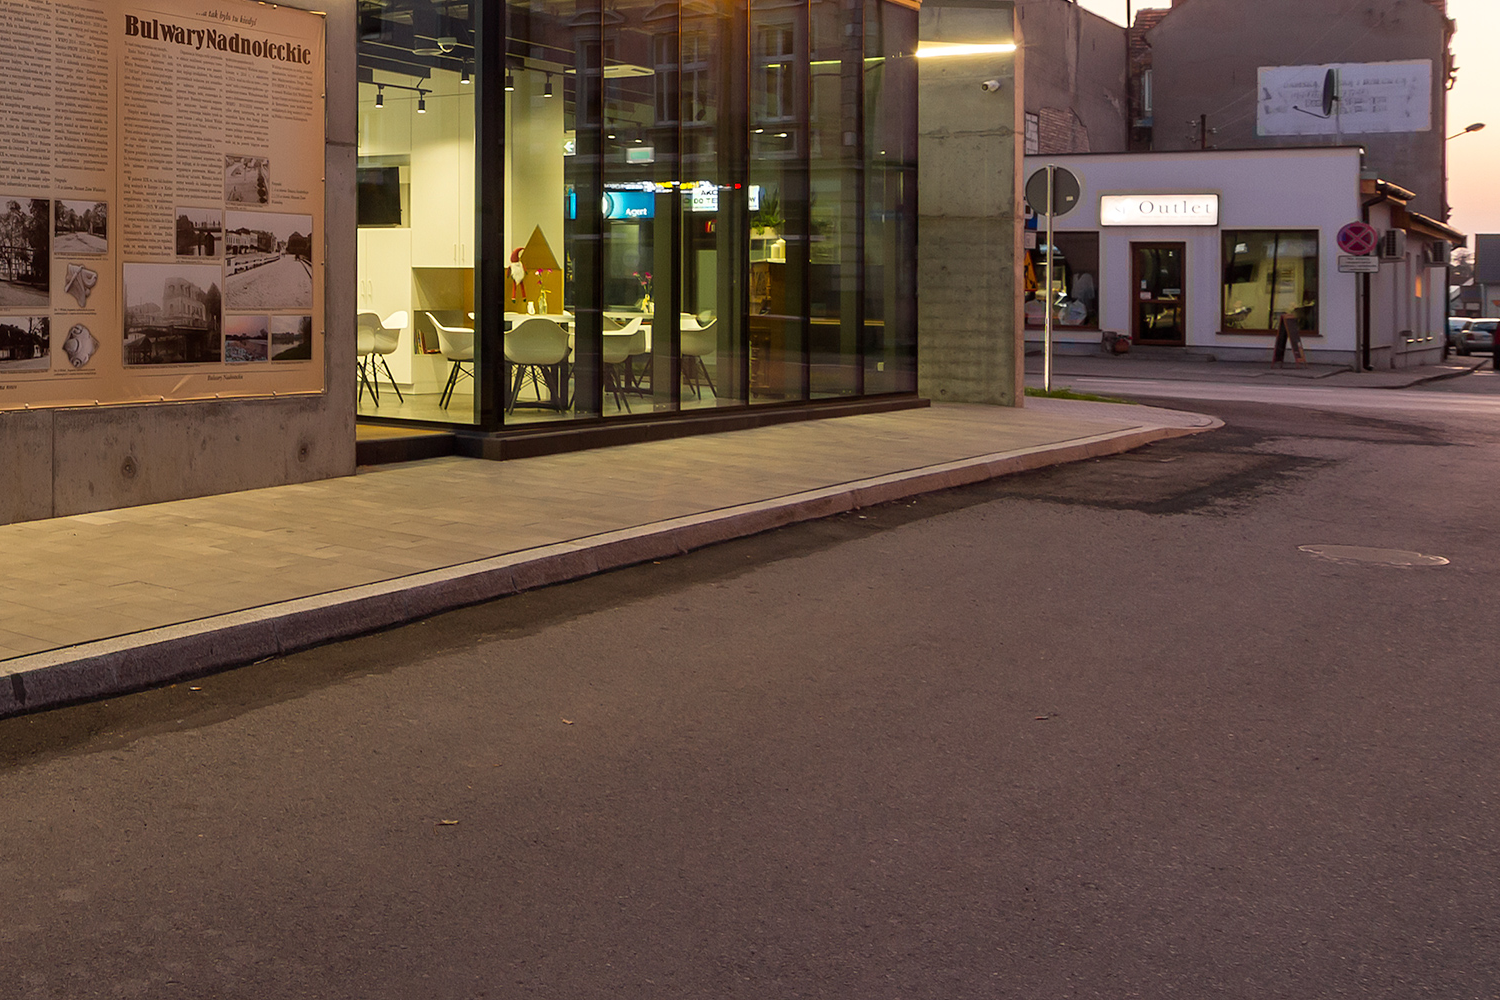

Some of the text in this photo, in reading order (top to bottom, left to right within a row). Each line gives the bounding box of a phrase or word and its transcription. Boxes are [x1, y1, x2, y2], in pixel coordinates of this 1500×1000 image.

[125, 15, 311, 65] Bulwary Nadnoteckie
[1139, 200, 1212, 214] Outlet
